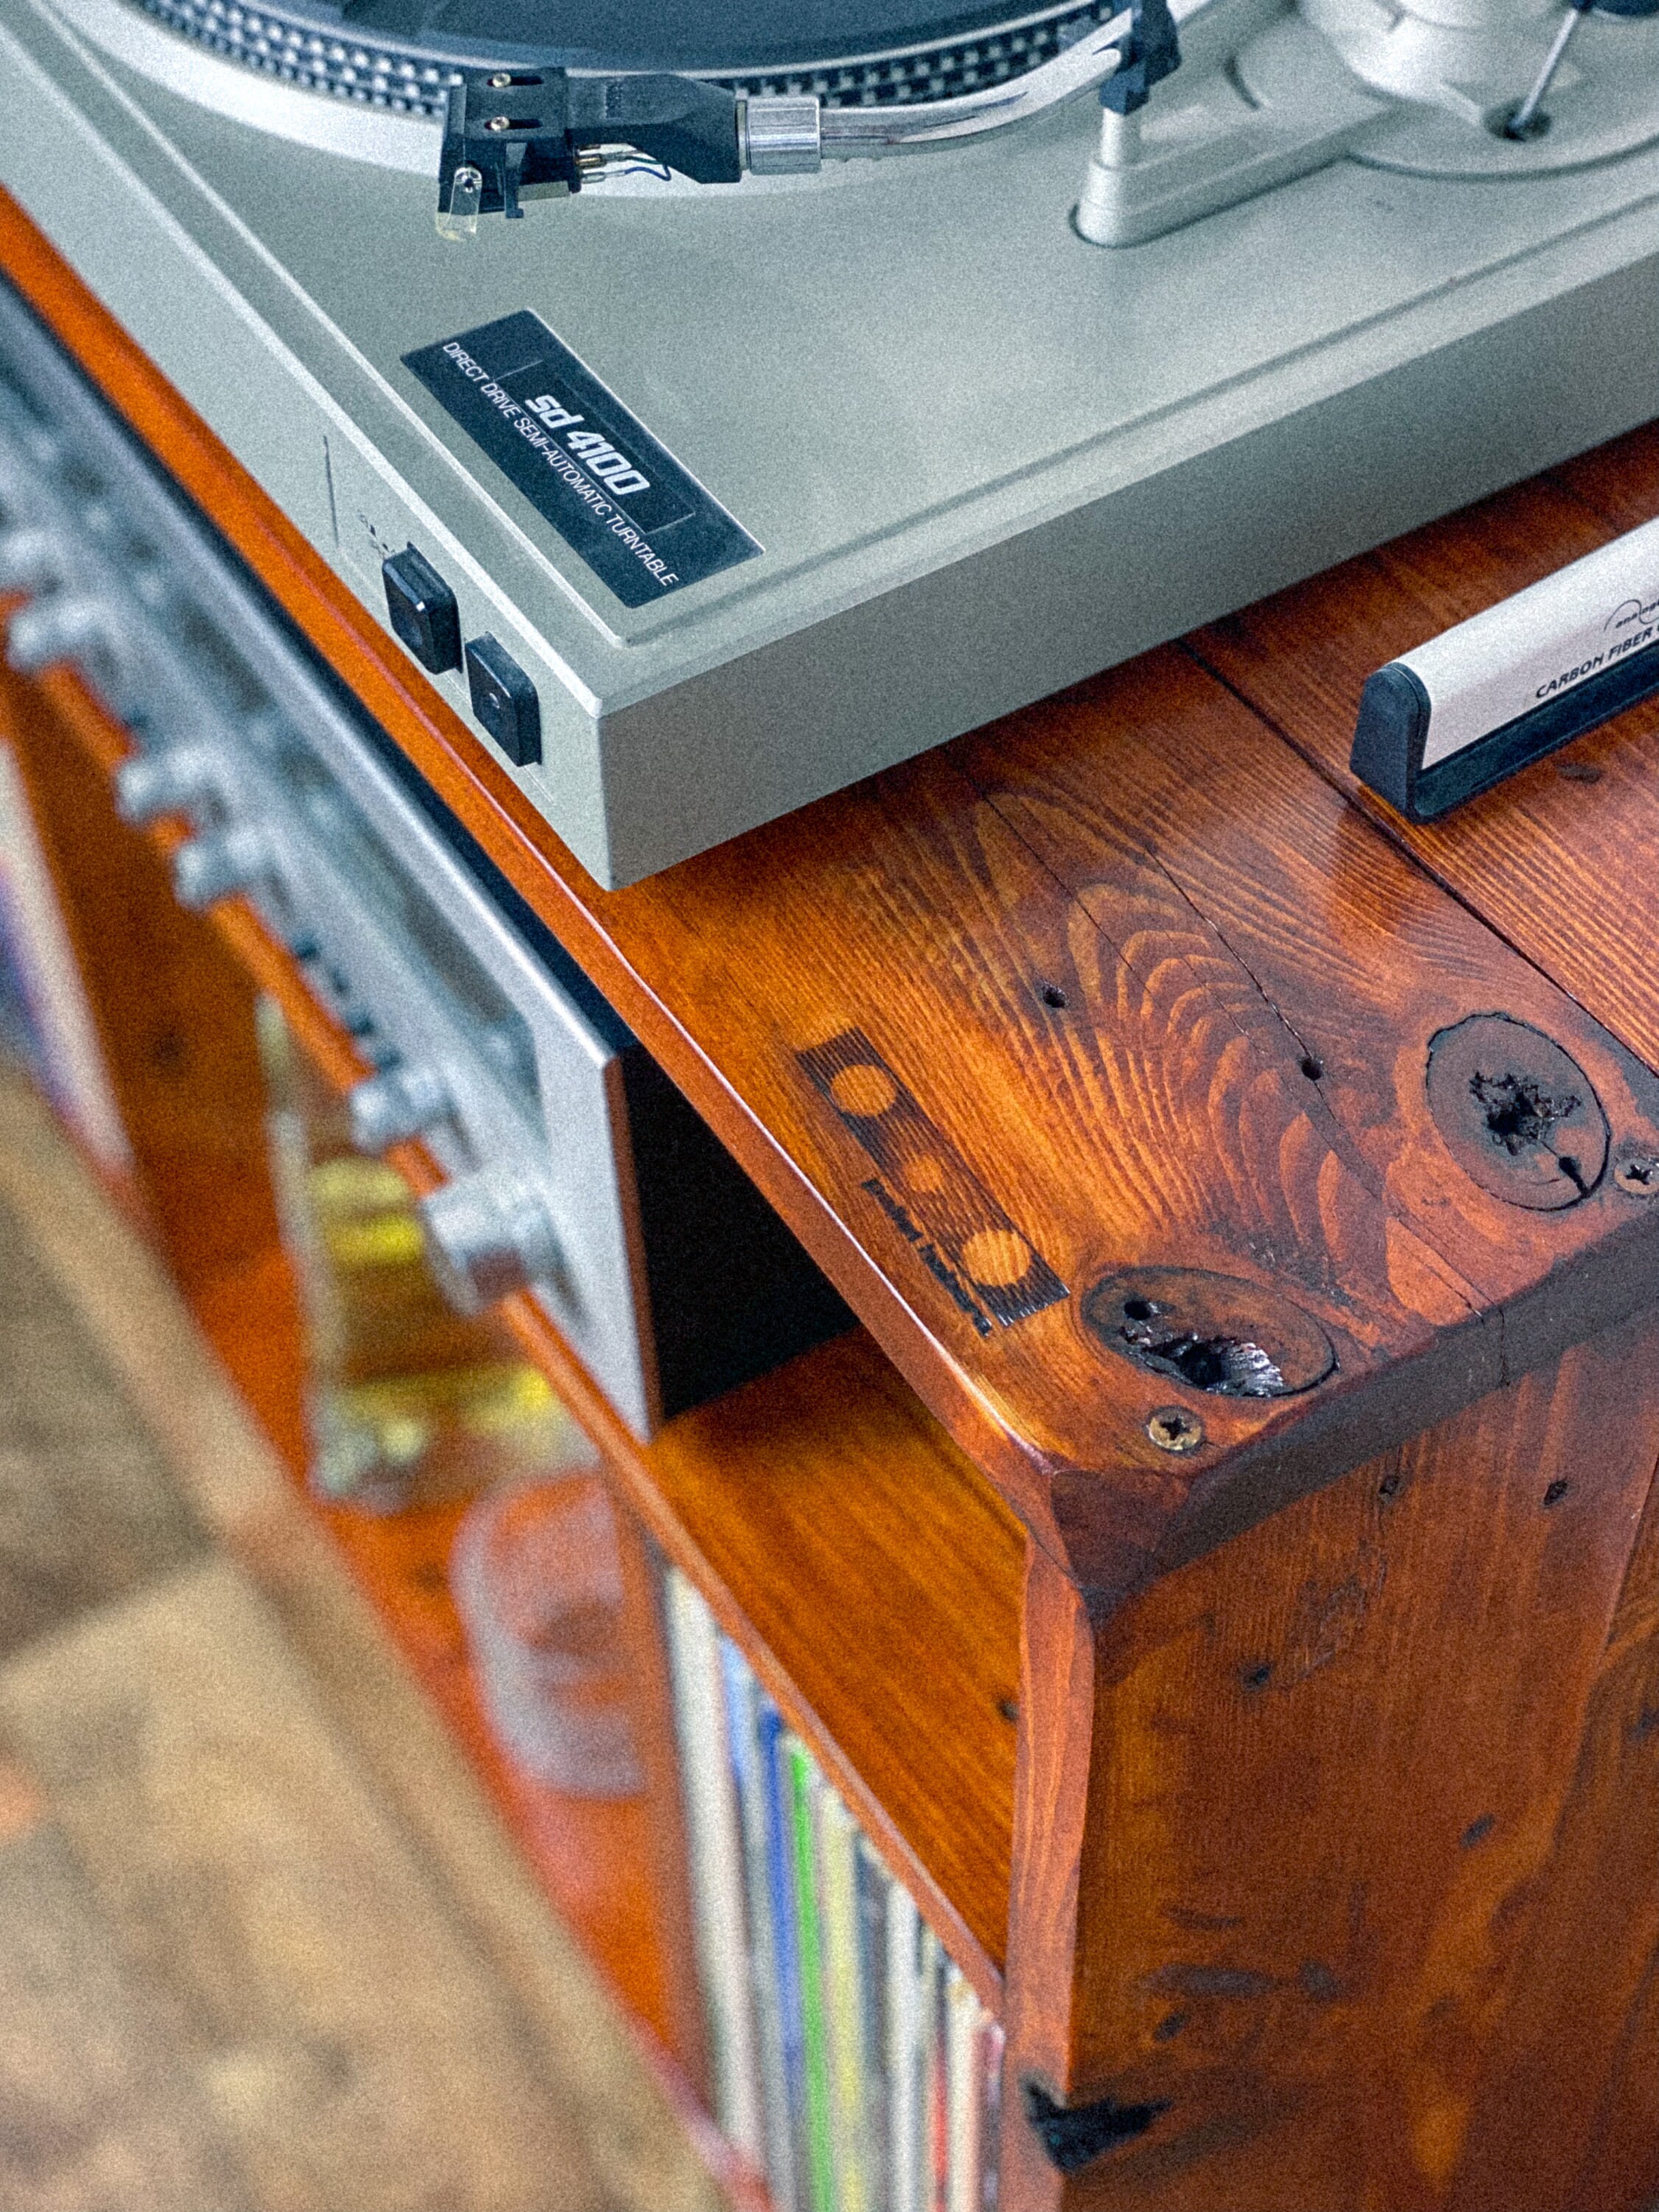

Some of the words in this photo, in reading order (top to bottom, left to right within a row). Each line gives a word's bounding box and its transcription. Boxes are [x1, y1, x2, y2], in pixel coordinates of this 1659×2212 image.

[442, 341, 490, 382] DIRECT
[481, 383, 521, 419] DRIVE
[513, 417, 612, 515] SEMI-AUTOMATIC
[605, 513, 679, 586] TURNTABLE
[524, 394, 585, 429] sd
[566, 431, 650, 495] 4100
[1535, 653, 1604, 699] CARBON
[1607, 626, 1653, 661] FIBER
